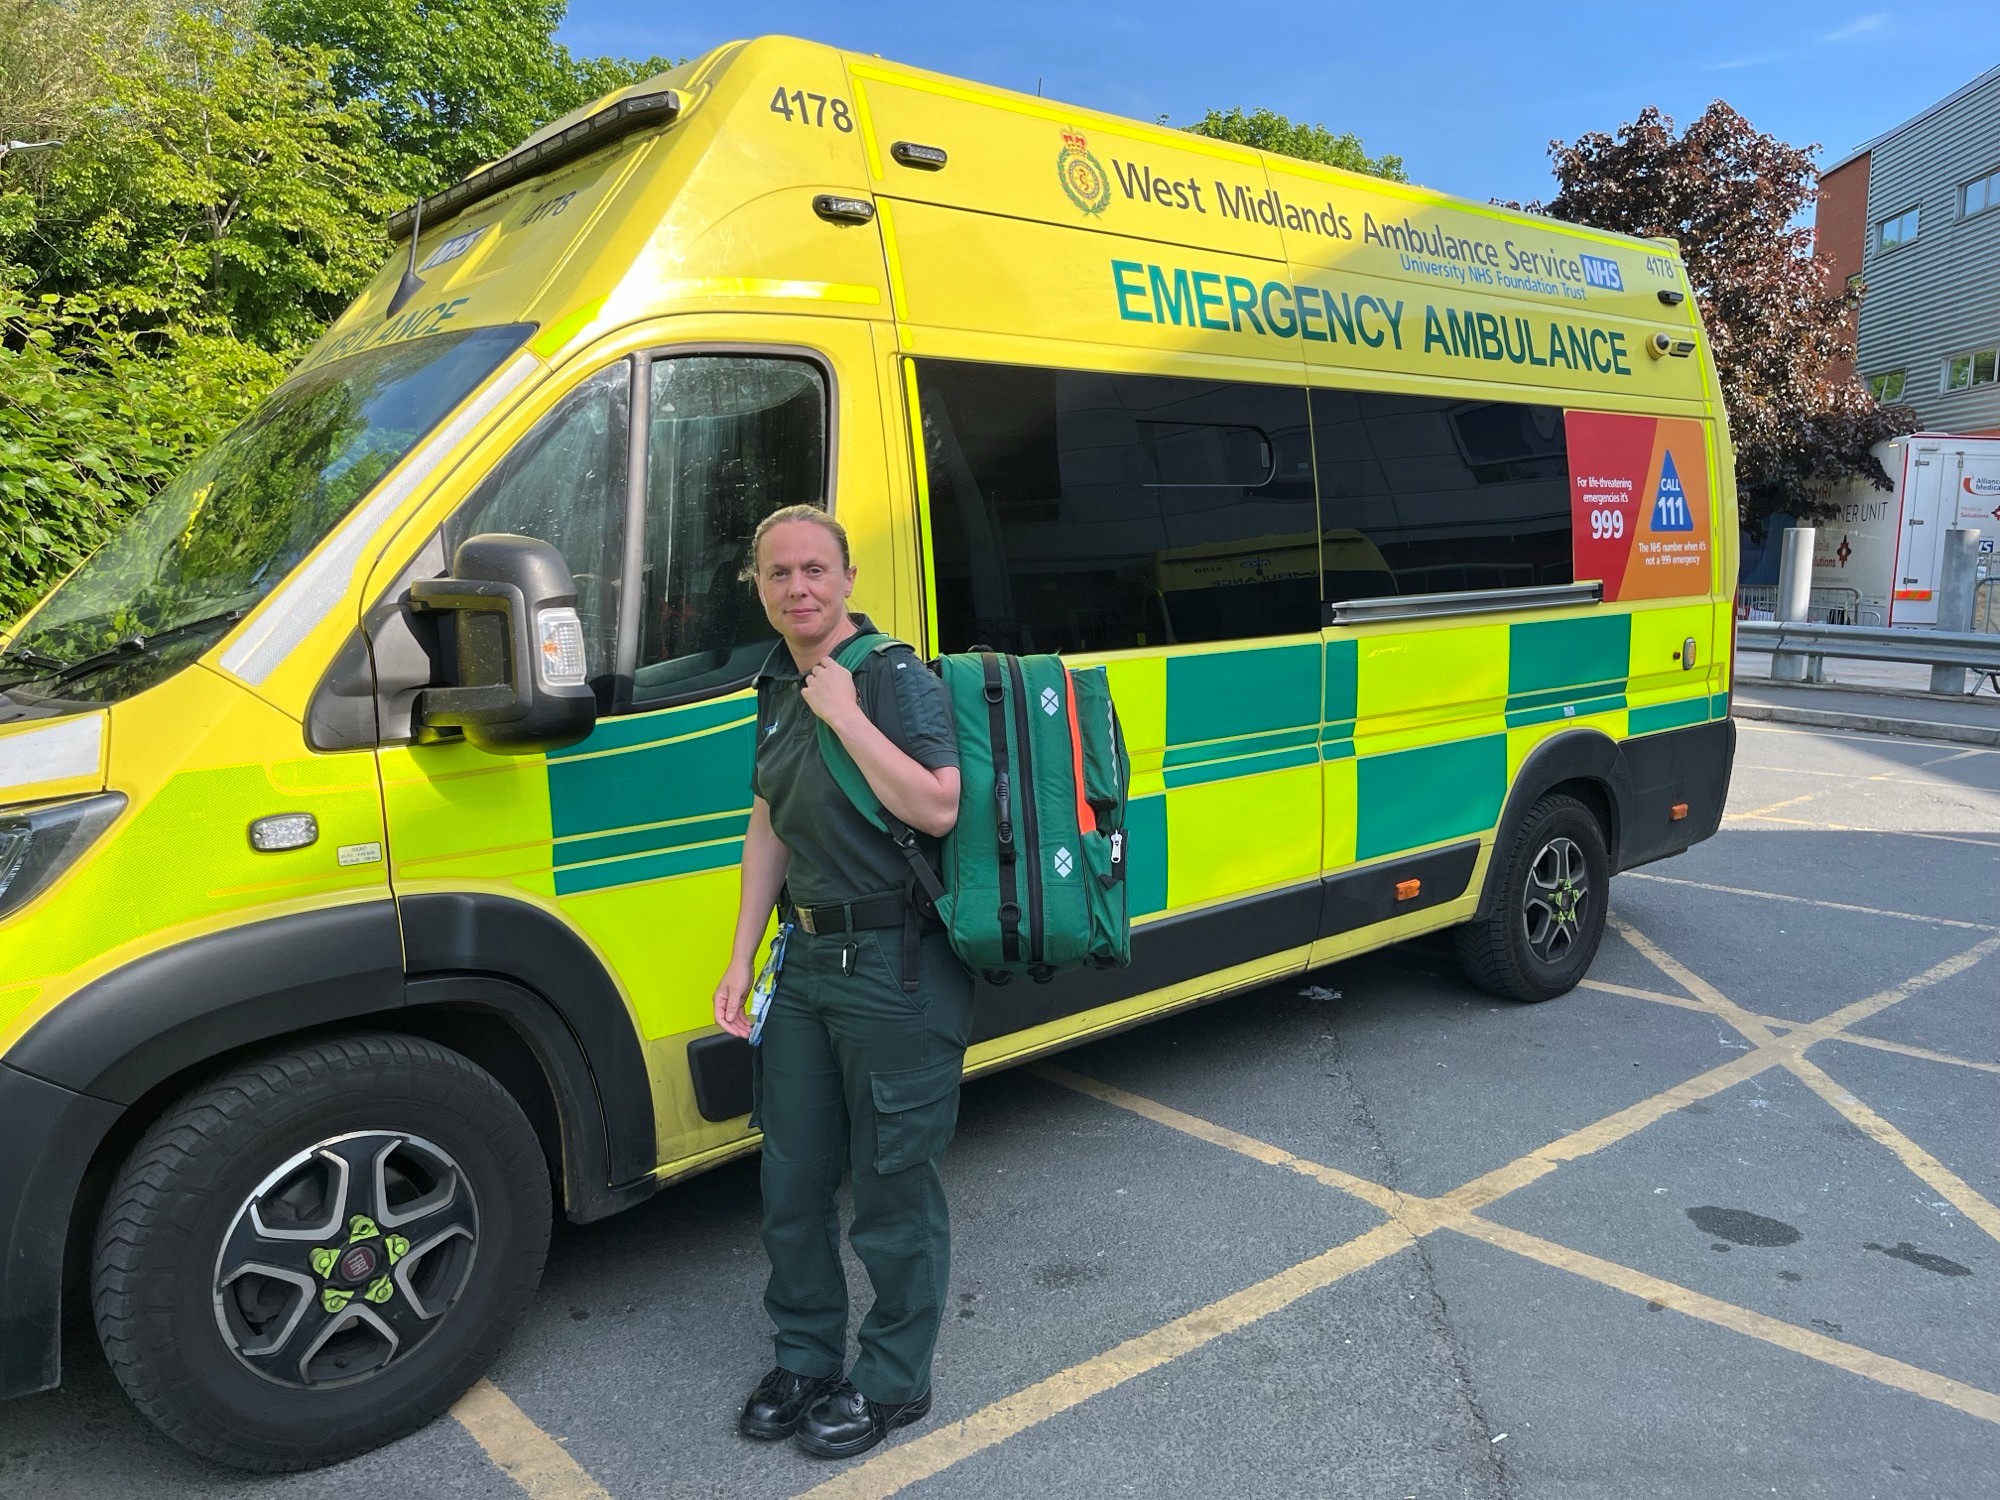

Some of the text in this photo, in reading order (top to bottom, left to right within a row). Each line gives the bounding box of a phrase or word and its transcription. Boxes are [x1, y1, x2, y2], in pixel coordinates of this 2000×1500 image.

[770, 86, 854, 133] 4178
[520, 190, 577, 229] 4178
[1112, 159, 1206, 214] West
[1215, 181, 1353, 240] Midlands
[1363, 213, 1499, 268] Ambulance
[1504, 240, 1582, 282] Service
[1583, 259, 1622, 290] NHS
[1401, 253, 1587, 300] University NHS Foundation Trust
[1646, 255, 1675, 279] 4178
[1111, 259, 1632, 376] EMERGENCY AMBULANCE
[1577, 476, 1632, 491] For life-threatening
[1660, 478, 1681, 491] CALL
[1976, 477, 2000, 485] Allianc
[1583, 492, 1620, 506] emergencies
[1657, 496, 1685, 526] 111
[1861, 502, 1888, 521] UNIT
[1590, 510, 1624, 540] 999
[1638, 542, 1650, 553] The
[1650, 542, 1661, 552] NHS
[1662, 541, 1683, 552] number
[1683, 541, 1698, 551] when
[1645, 556, 1656, 566] not
[1661, 555, 1671, 565] 999
[1672, 556, 1700, 567] emergency
[347, 1253, 370, 1277] FIAT
